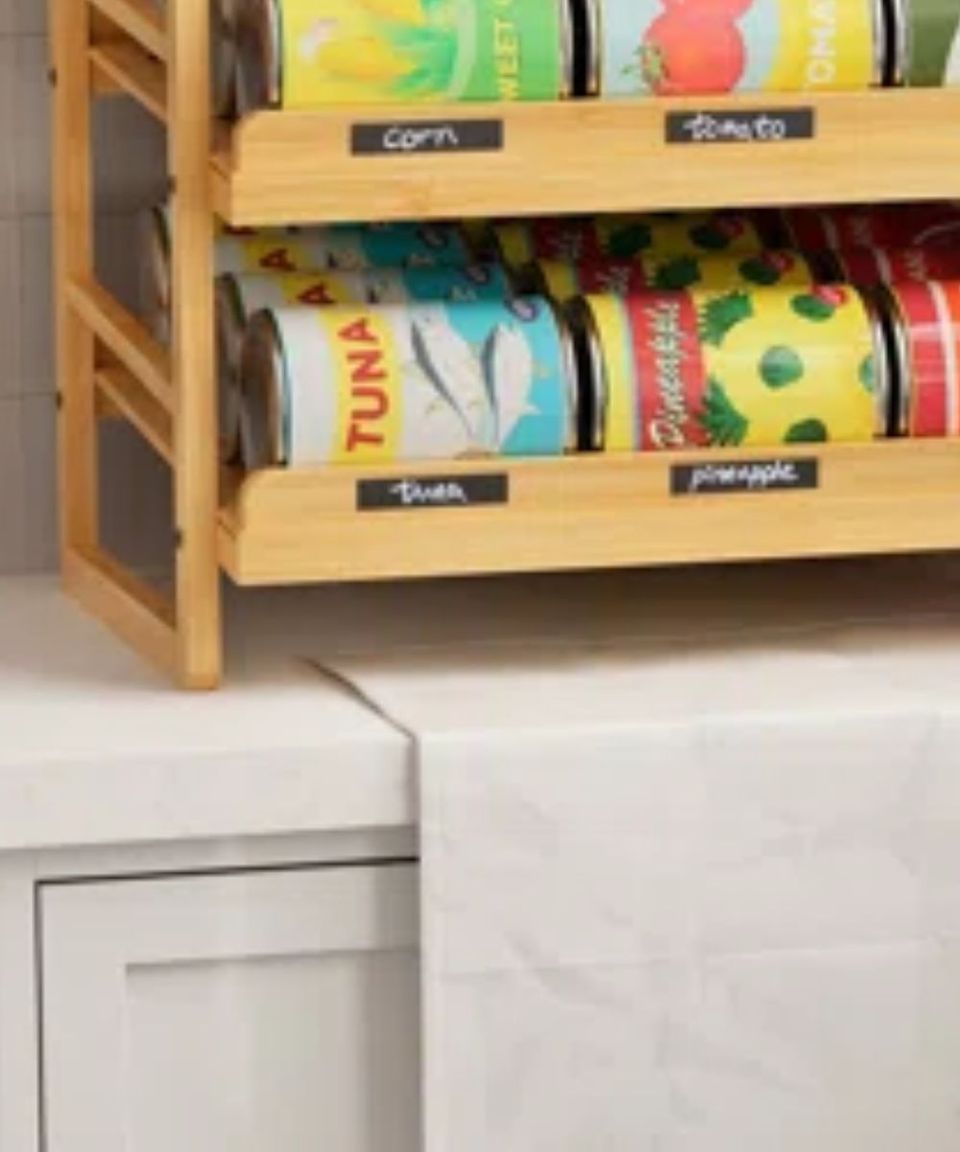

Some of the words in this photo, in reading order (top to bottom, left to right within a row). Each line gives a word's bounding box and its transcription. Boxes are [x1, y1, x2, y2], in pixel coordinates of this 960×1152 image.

[493, 16, 519, 101] WEET
[382, 125, 459, 150] corn
[337, 317, 390, 452] TUNA
